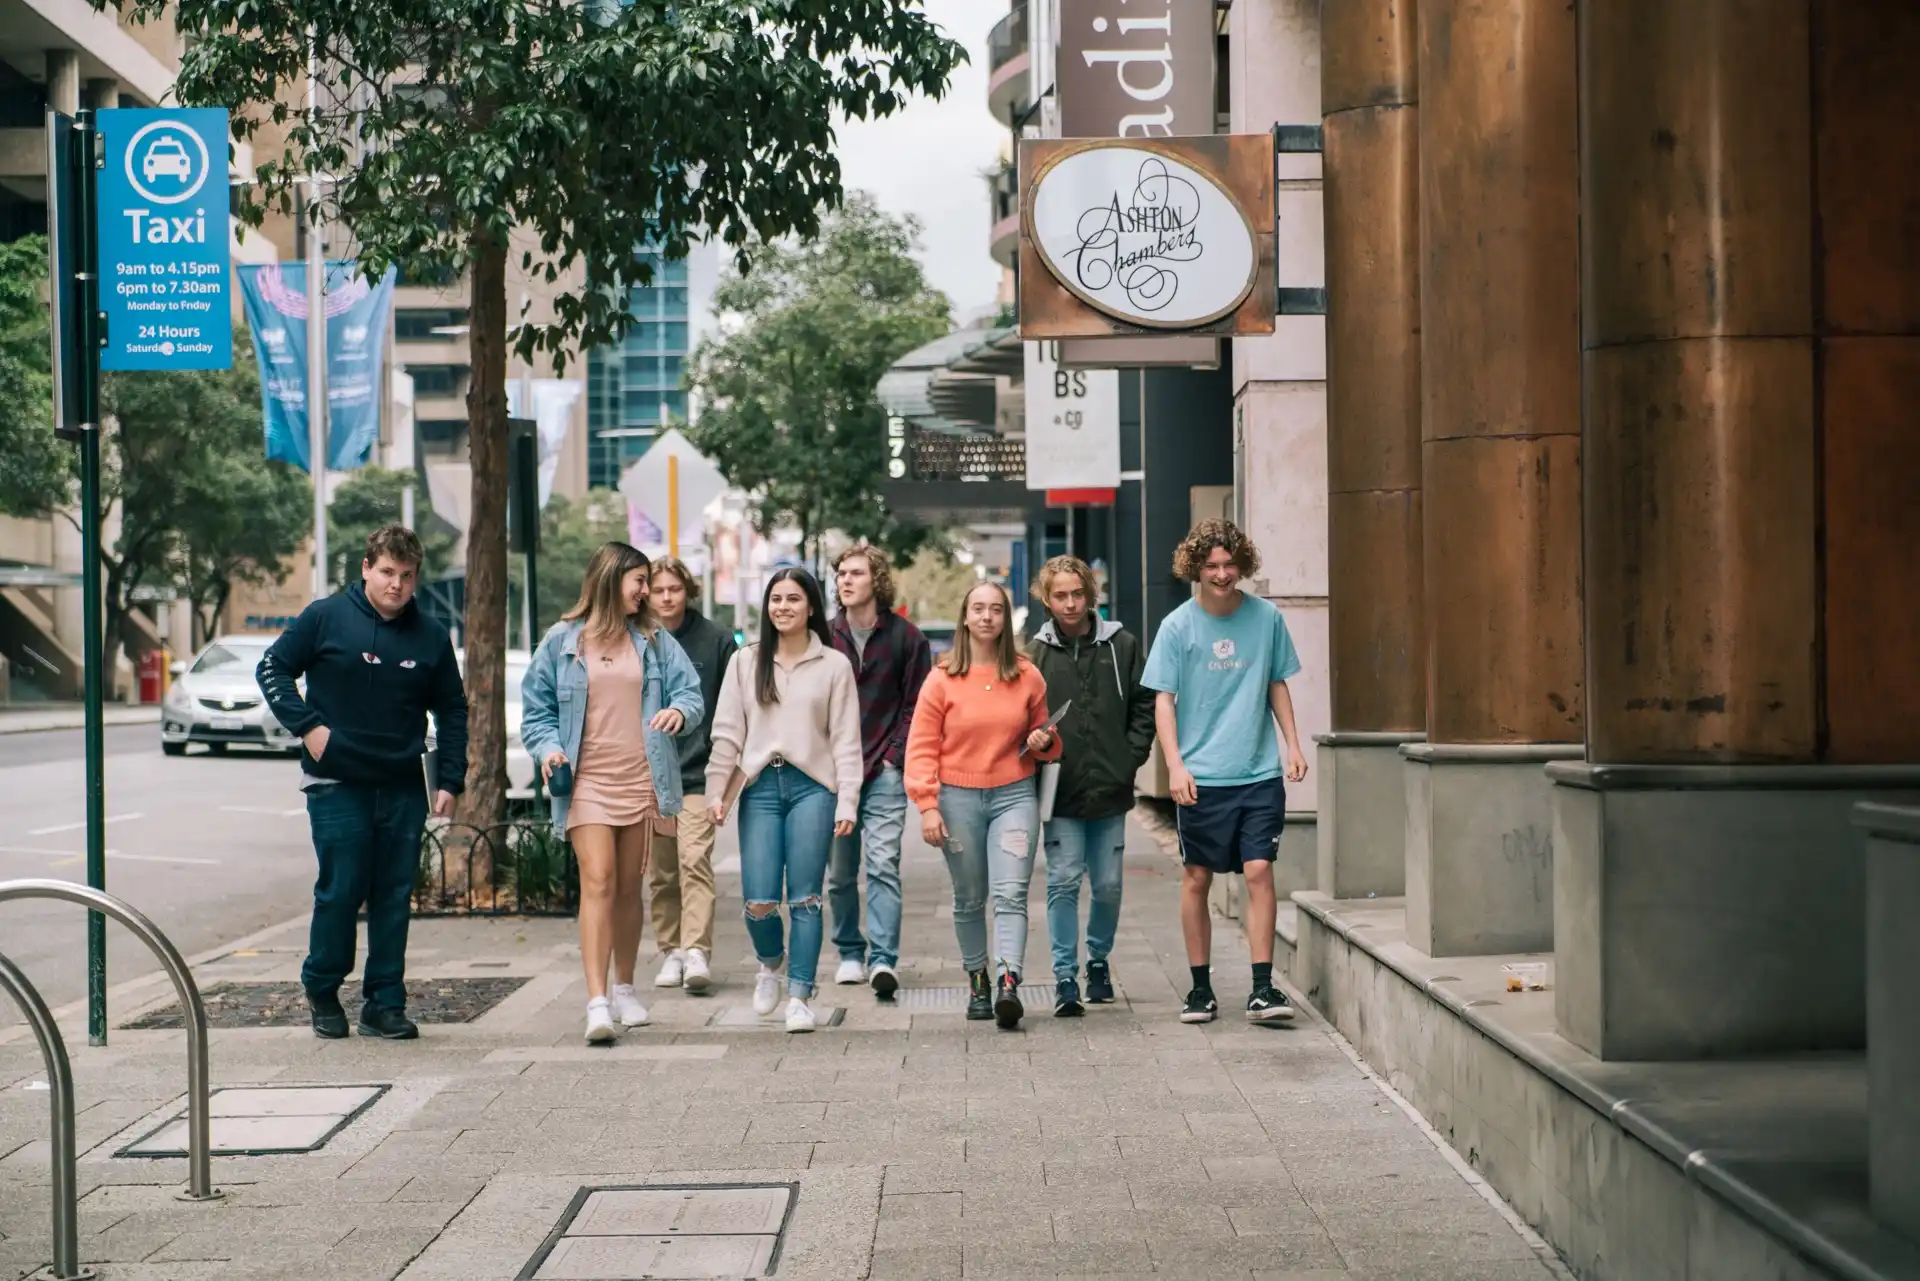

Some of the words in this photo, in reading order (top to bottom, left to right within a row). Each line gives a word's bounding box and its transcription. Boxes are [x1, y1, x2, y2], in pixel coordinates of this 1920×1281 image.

[1082, 0, 1174, 137] adi
[123, 208, 205, 243] Taxi
[1070, 225, 1200, 290] Chambers
[116, 262, 146, 275] 9am
[150, 263, 164, 275] to
[167, 262, 220, 277] 4.15pm
[116, 282, 148, 296] 6pm
[152, 282, 166, 294] to
[169, 281, 220, 294] 7.30am
[127, 301, 166, 312] Monday
[169, 301, 179, 310] to
[138, 325, 156, 338] 24
[159, 325, 200, 338] Hours
[177, 343, 213, 354] Sunday
[887, 410, 905, 478] E79
